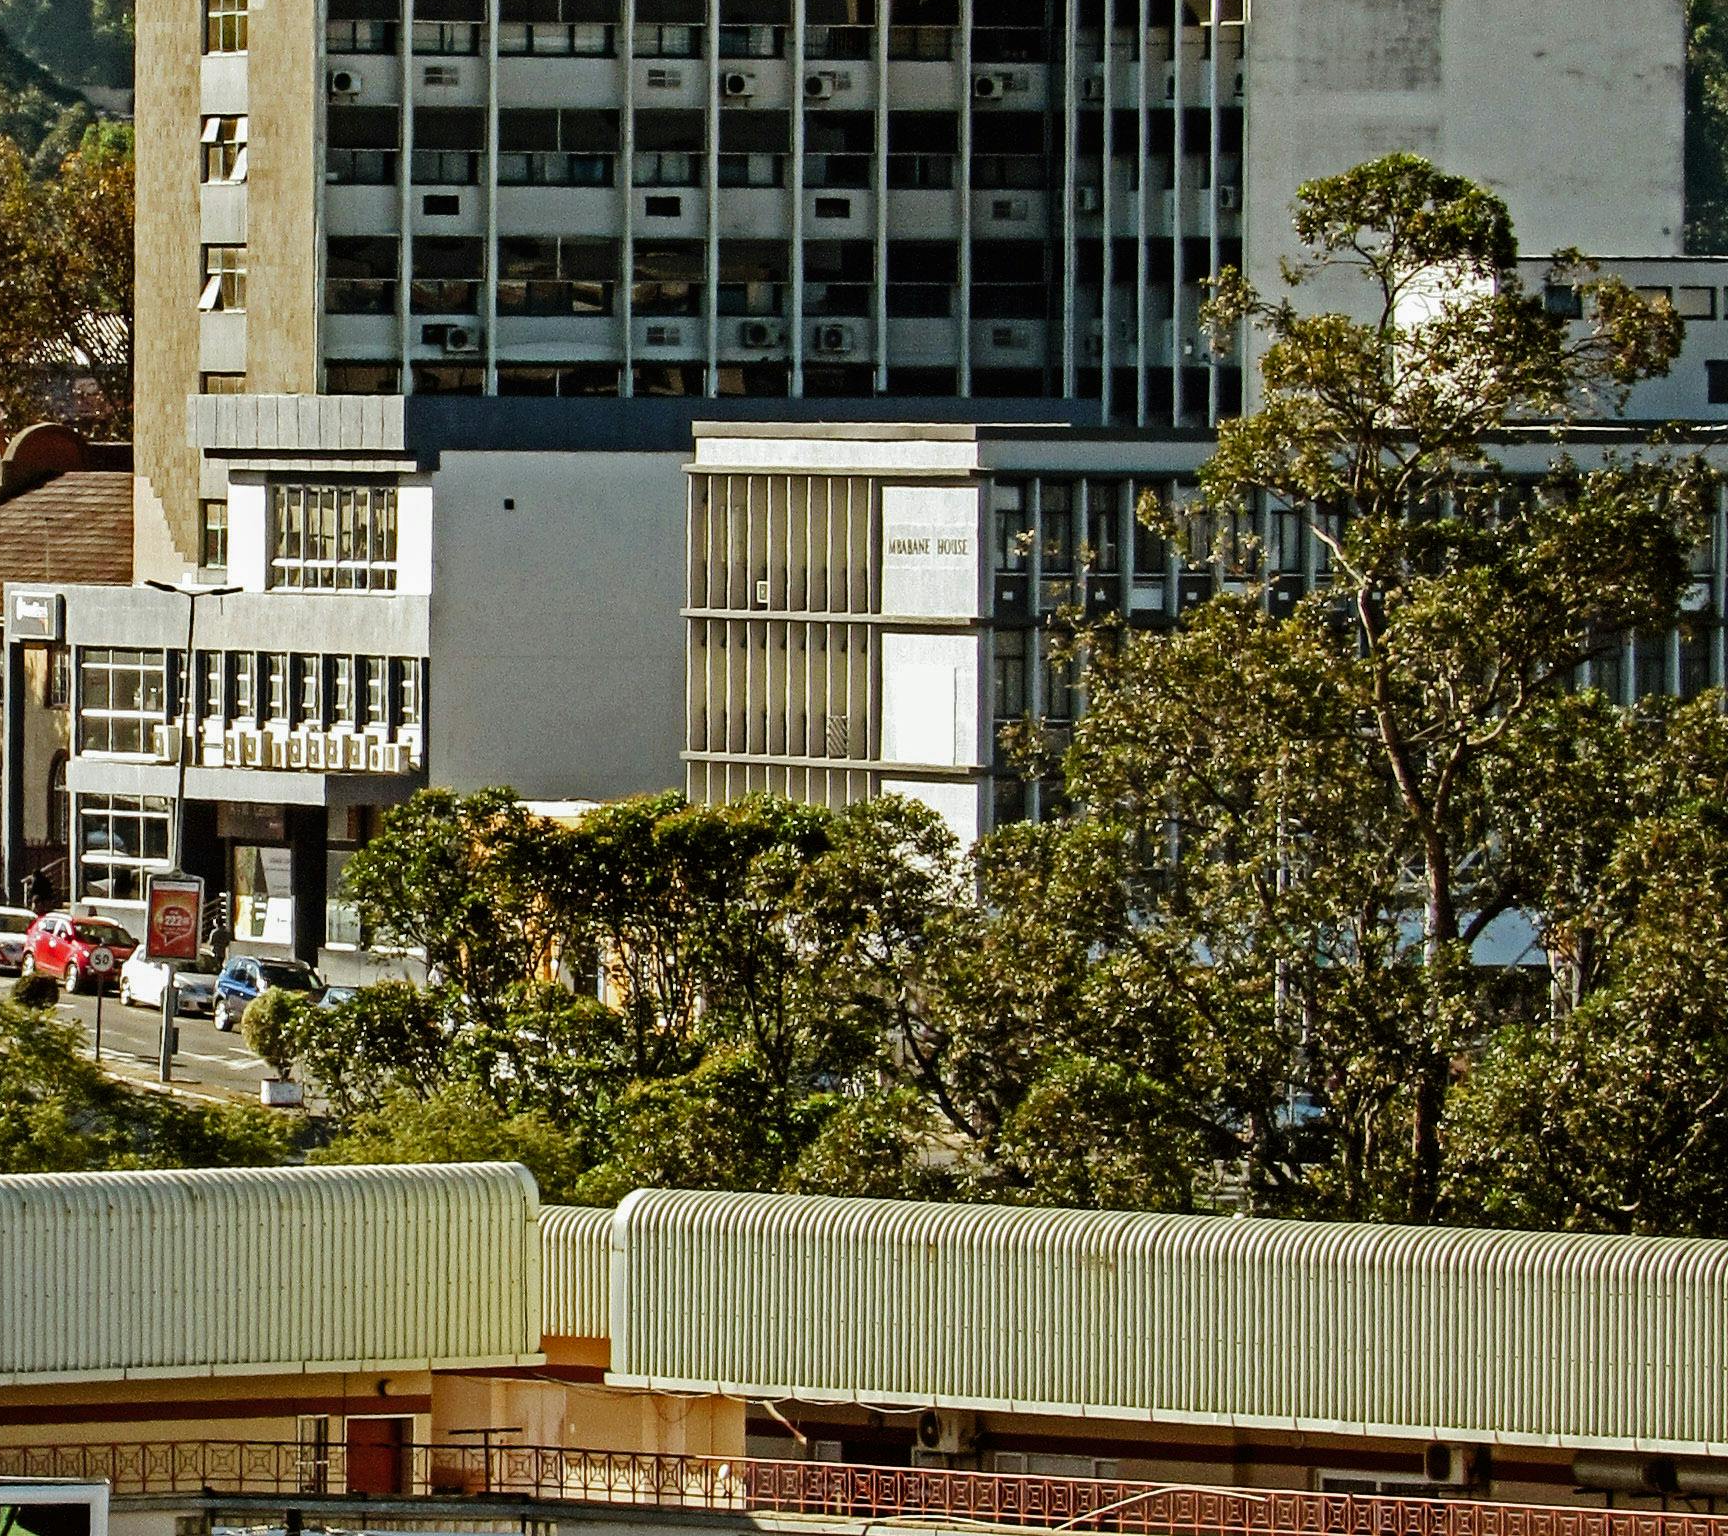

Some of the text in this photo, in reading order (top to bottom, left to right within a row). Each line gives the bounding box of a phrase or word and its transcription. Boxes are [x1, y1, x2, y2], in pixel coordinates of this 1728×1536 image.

[889, 538, 969, 555] MBABANE HOUSE
[94, 952, 109, 964] 50
